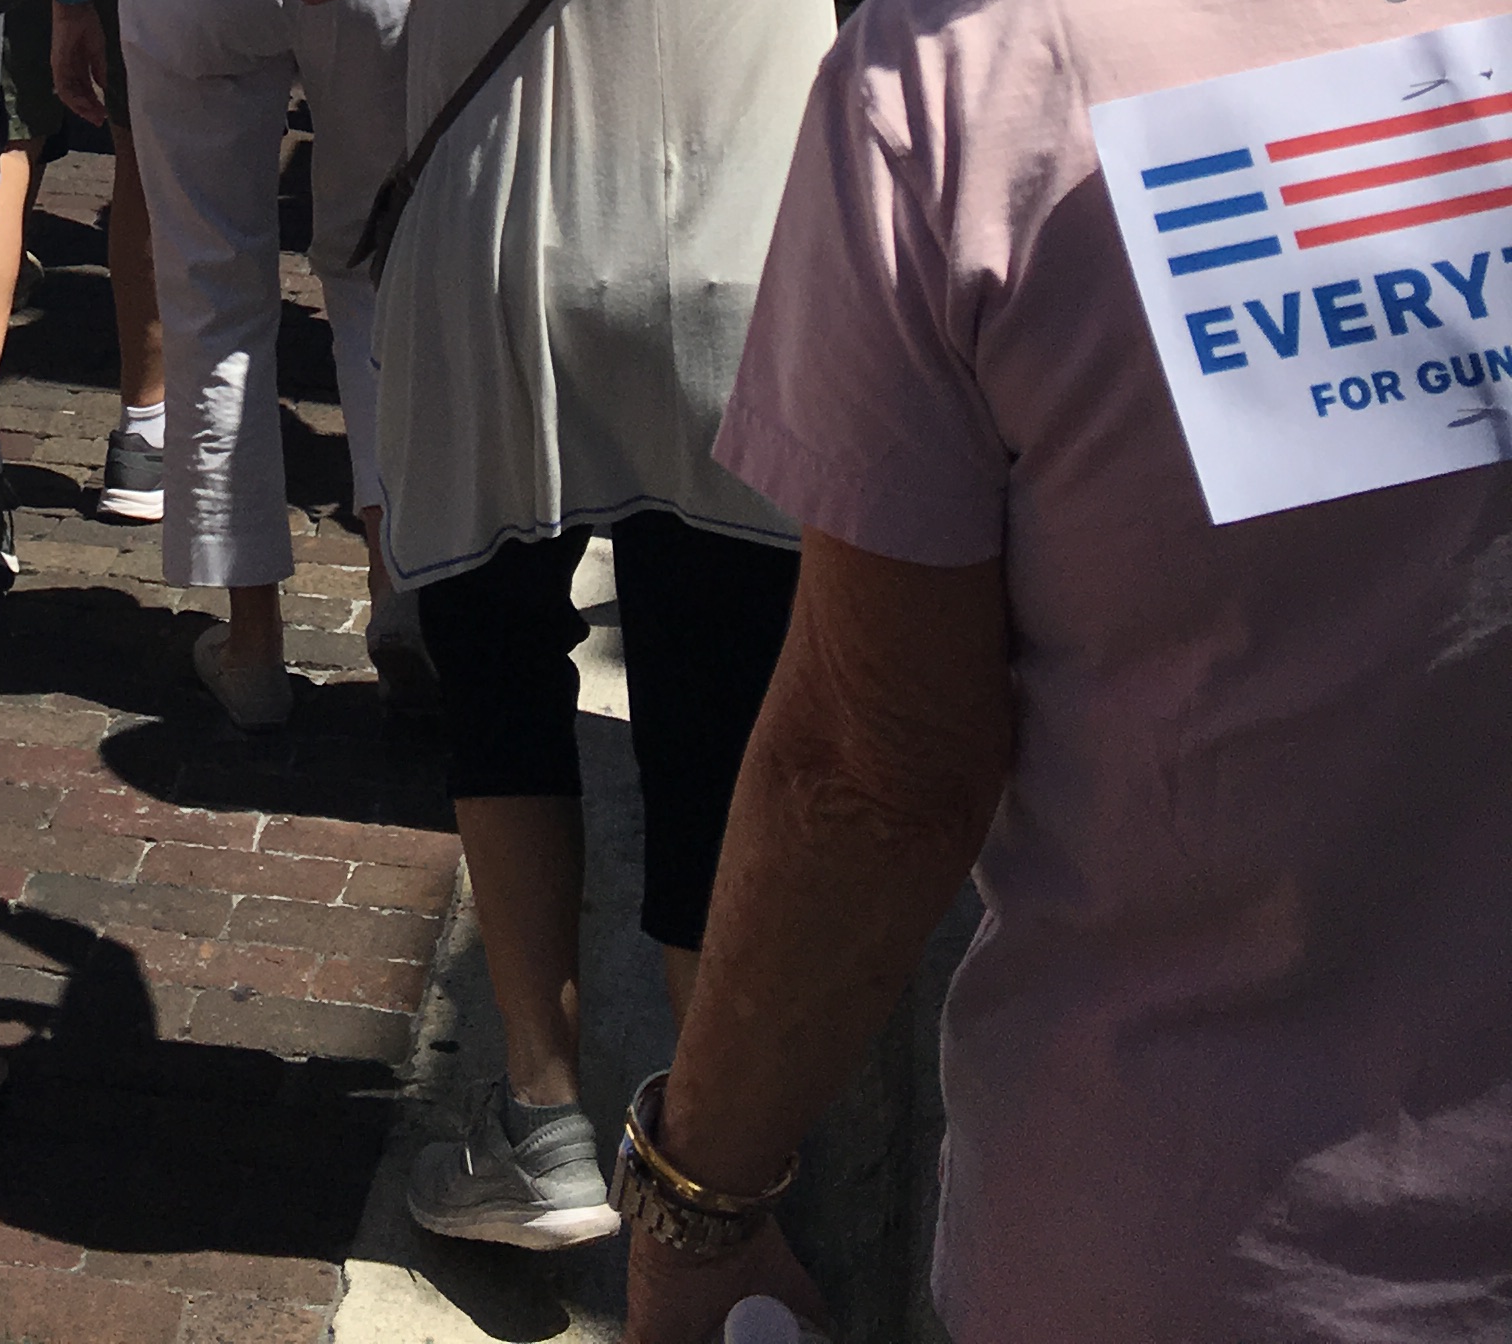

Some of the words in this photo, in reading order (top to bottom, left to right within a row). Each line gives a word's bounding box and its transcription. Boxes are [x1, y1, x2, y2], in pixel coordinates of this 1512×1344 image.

[1185, 245, 1512, 376] EVERY
[1310, 369, 1406, 418] FOR
[1417, 344, 1512, 396] GUN
